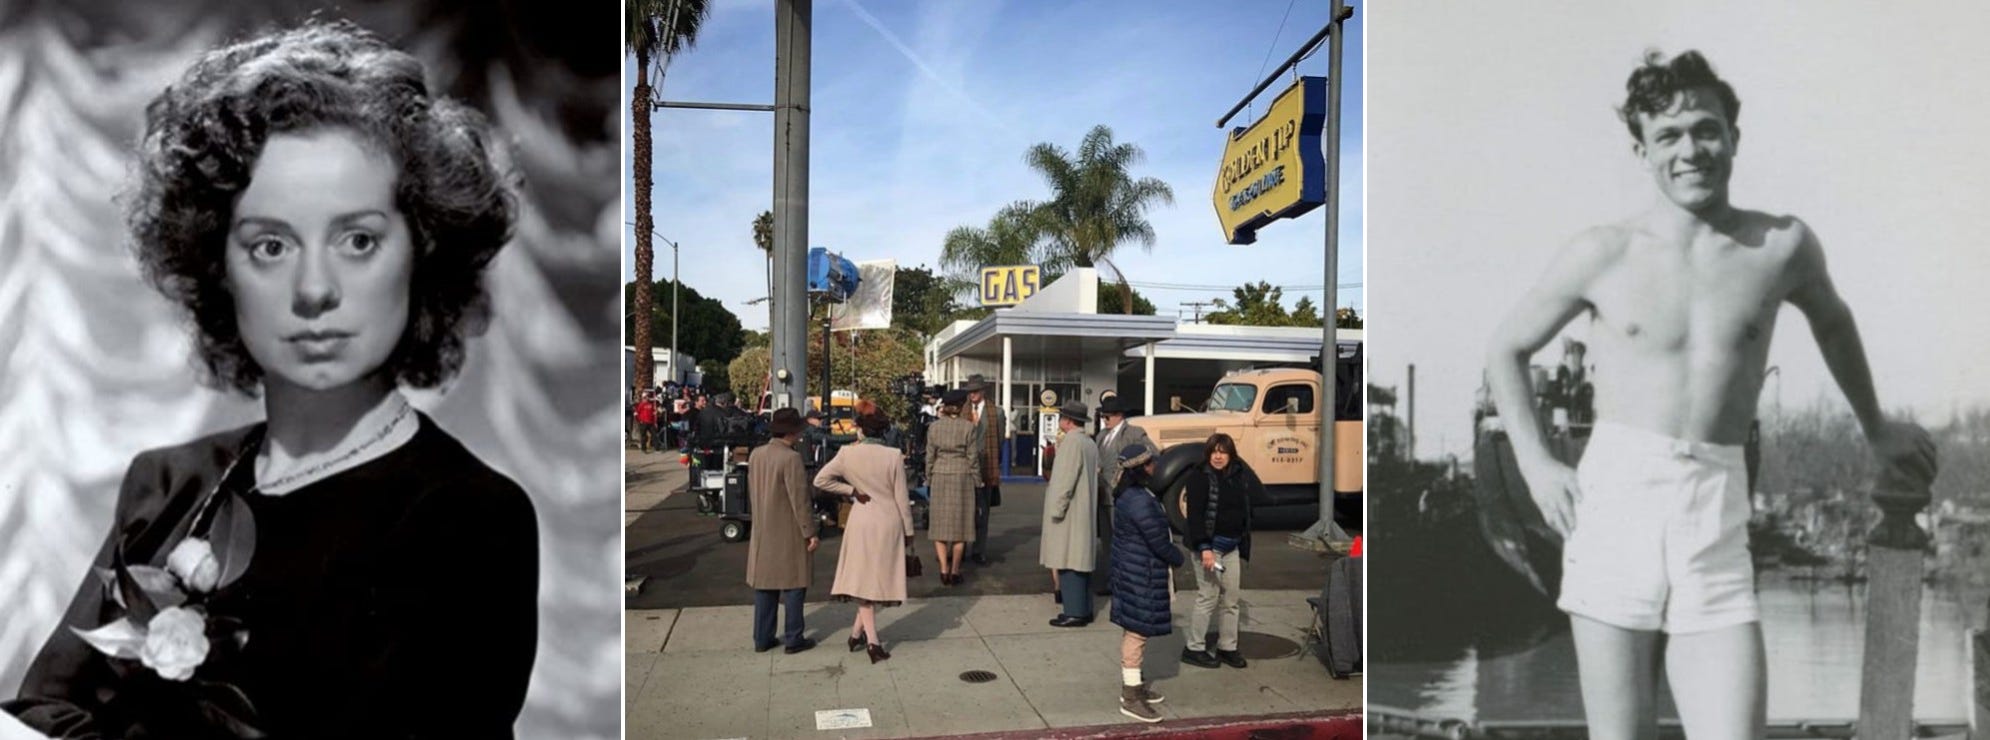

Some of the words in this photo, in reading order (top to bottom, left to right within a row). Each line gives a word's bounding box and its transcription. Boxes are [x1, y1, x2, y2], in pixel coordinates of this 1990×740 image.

[1222, 137, 1269, 194] GOLDEN
[1273, 119, 1295, 161] TIP
[1229, 165, 1284, 211] GASOLINE
[984, 269, 1037, 301] GAS
